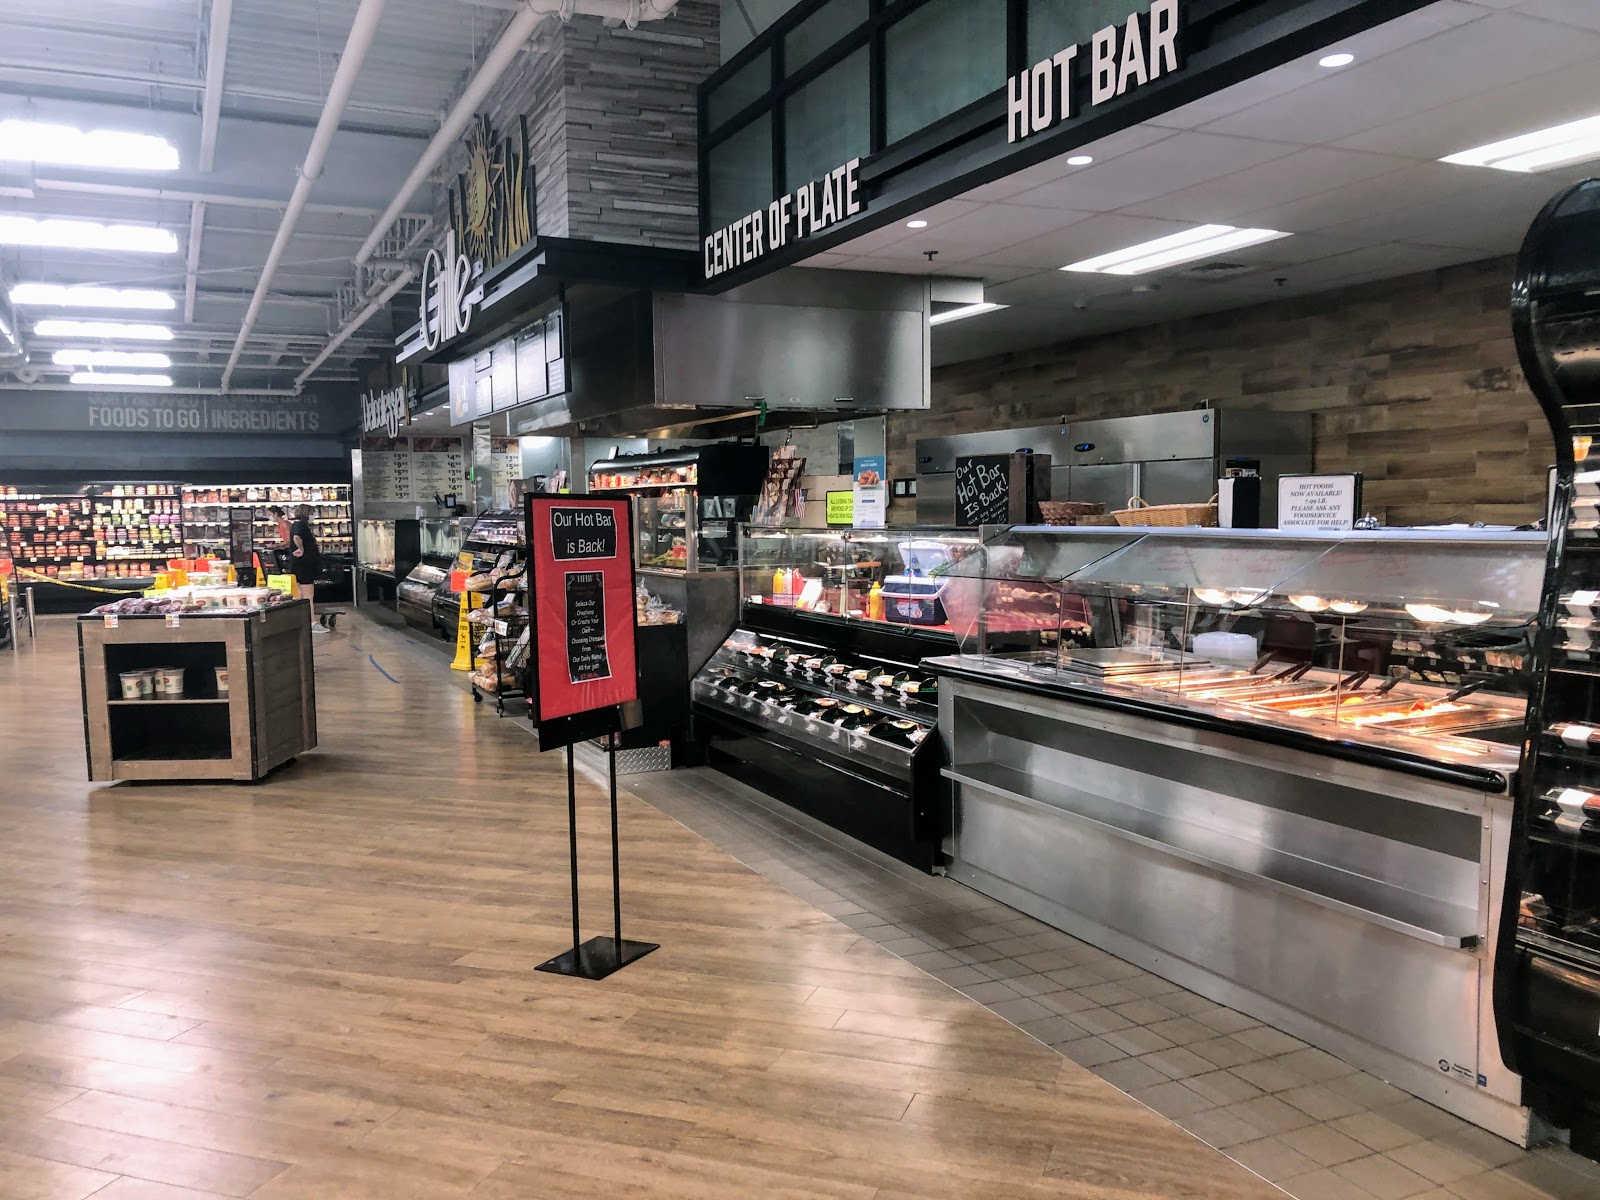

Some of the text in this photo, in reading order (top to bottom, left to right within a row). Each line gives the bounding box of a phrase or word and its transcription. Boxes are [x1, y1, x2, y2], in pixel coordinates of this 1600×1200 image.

[1008, 0, 1178, 144] HOT BAR
[704, 158, 860, 279] CENTER OF PLATE
[89, 406, 200, 429] FOODS TO GO
[211, 409, 320, 430] INGREDIENTS
[956, 459, 972, 479] Our
[957, 474, 978, 504] Hot
[976, 464, 1000, 489] Bar
[979, 473, 1008, 507] Back!
[554, 512, 611, 526] Our Hot Bar
[567, 538, 605, 554] is Back!
